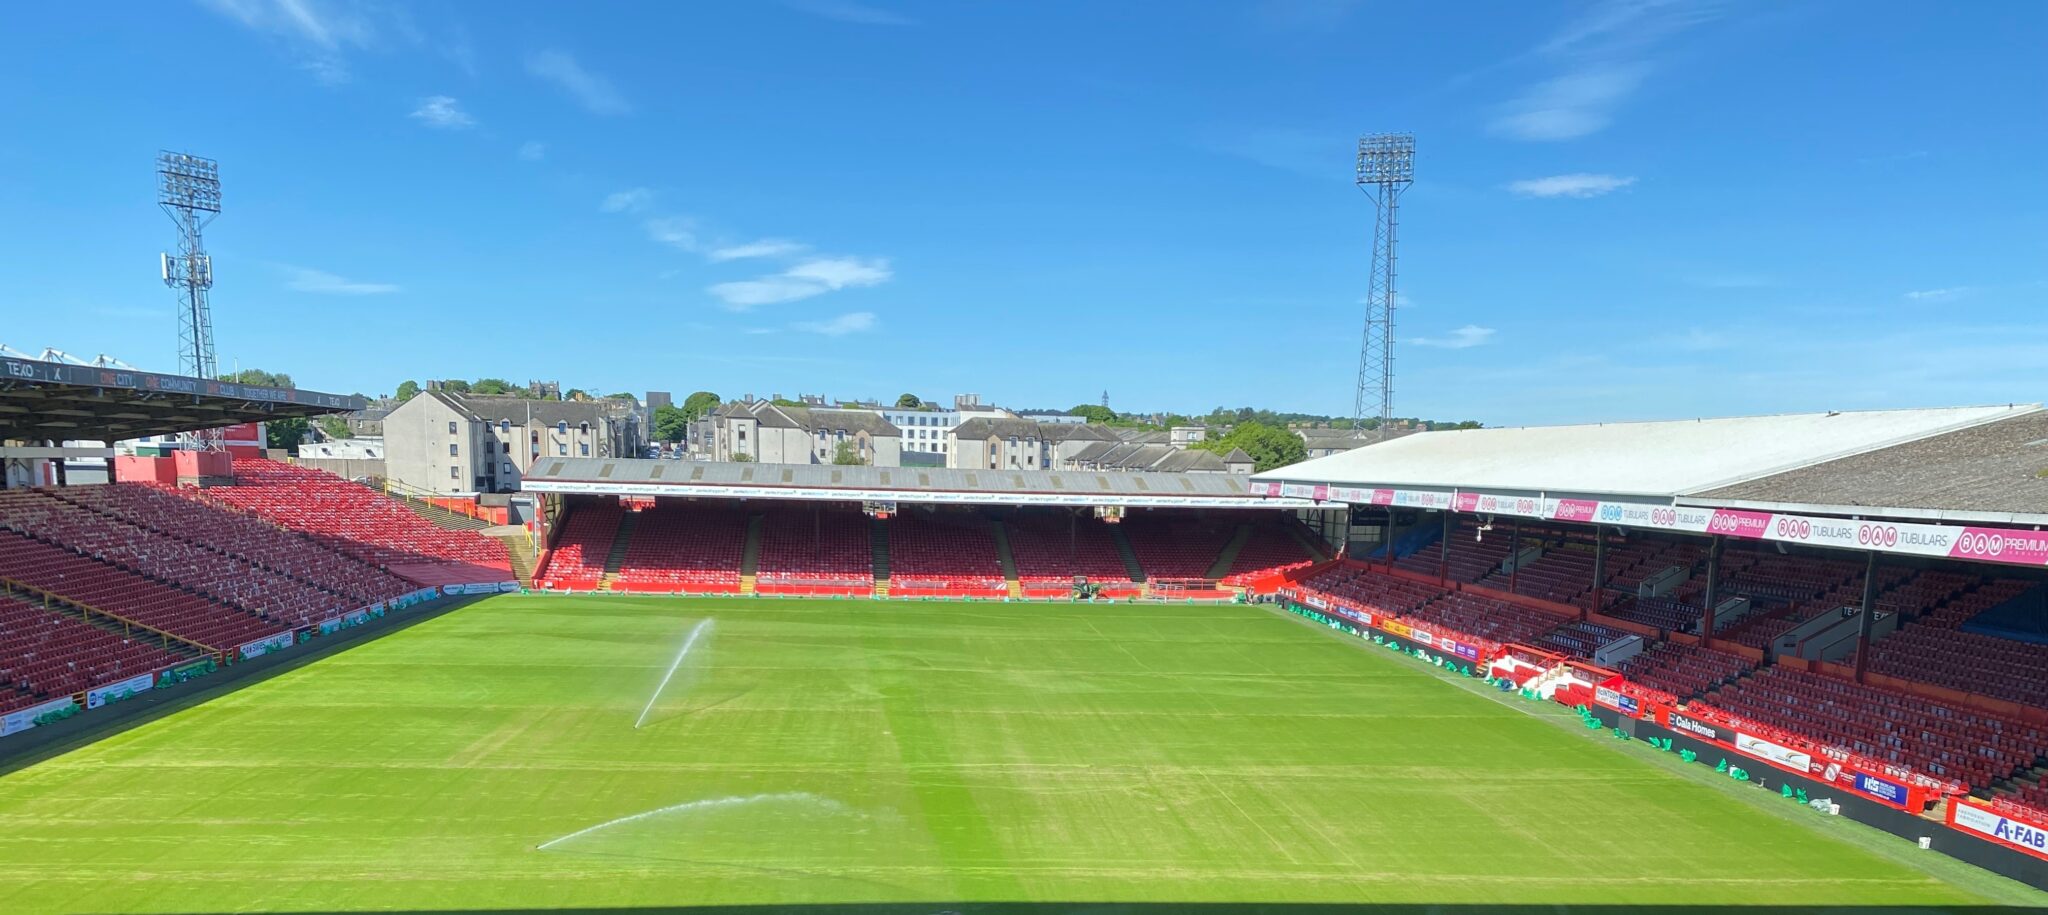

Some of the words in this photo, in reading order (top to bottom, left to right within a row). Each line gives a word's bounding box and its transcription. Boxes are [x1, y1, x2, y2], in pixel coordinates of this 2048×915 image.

[6, 361, 33, 377] TEXO
[117, 374, 133, 386] CITY
[160, 377, 197, 392] COMMUNITY
[1623, 509, 1649, 520] TUBULARS
[1652, 507, 1677, 526] RAM
[1677, 513, 1706, 525] TUBULARS
[1712, 513, 1738, 532] RAM
[1738, 517, 1766, 529] PREMIUM
[1777, 518, 1810, 540] RAM
[1812, 525, 1852, 539] TUBULARS
[1858, 524, 1897, 547] RAM
[1900, 532, 1948, 547] TUBULARS
[1959, 532, 2003, 556] RAM
[1676, 715, 1691, 730] Cala
[1691, 720, 1716, 738] Homes
